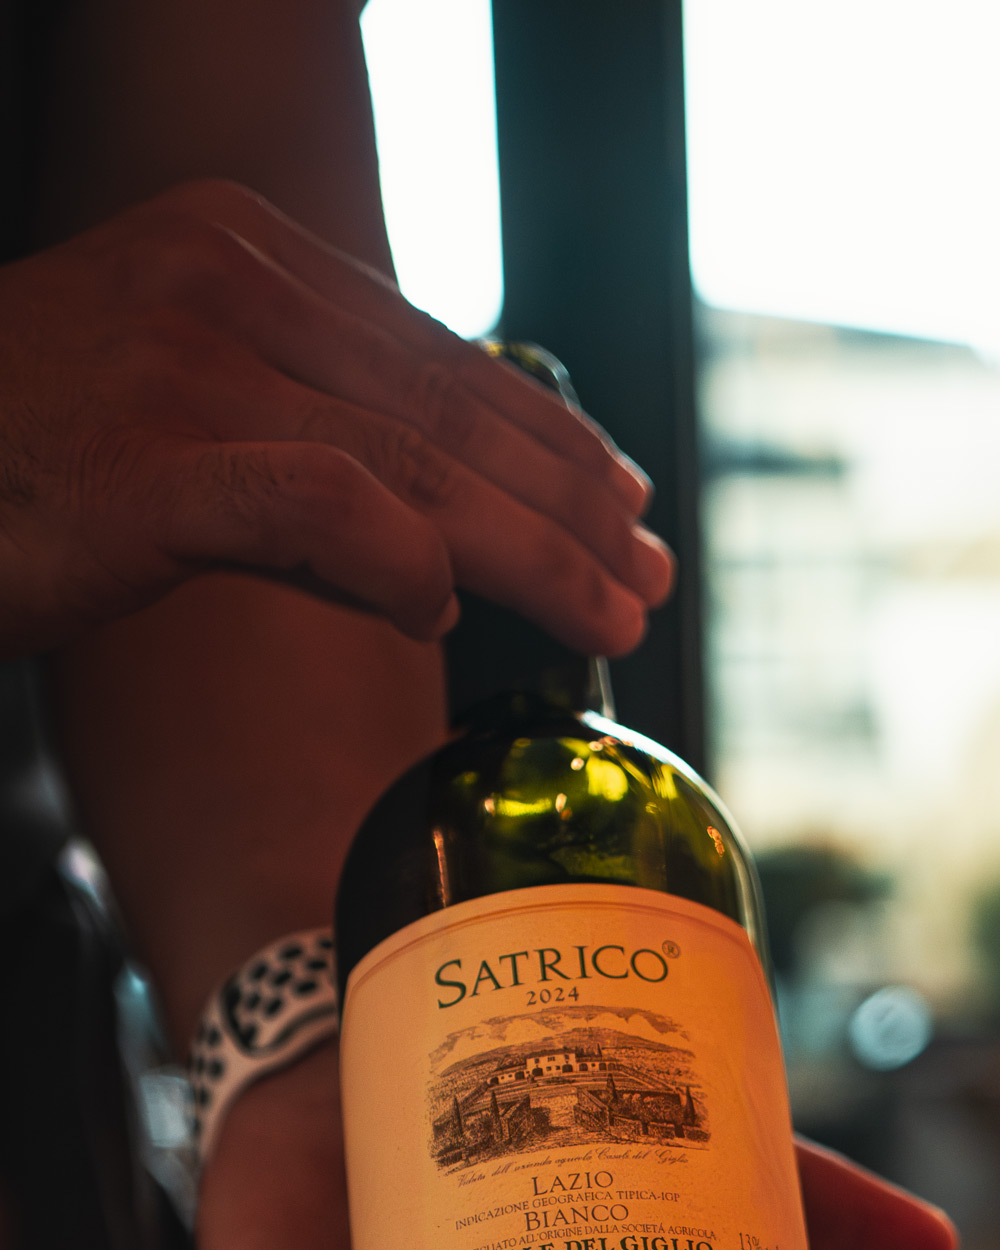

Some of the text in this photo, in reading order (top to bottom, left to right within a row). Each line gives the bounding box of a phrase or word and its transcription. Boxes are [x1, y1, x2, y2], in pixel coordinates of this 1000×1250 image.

[526, 986, 580, 1006] 2024
[531, 1171, 613, 1196] LAZIO
[455, 1200, 529, 1231] INDICAZIONE
[532, 1191, 613, 1209] GEOGRAFICA
[524, 1203, 629, 1232] BIANCO
[518, 1227, 582, 1246] ALL'ORIGINE
[585, 1224, 618, 1235] DALLA
[668, 1225, 717, 1241] AGRICOLA
